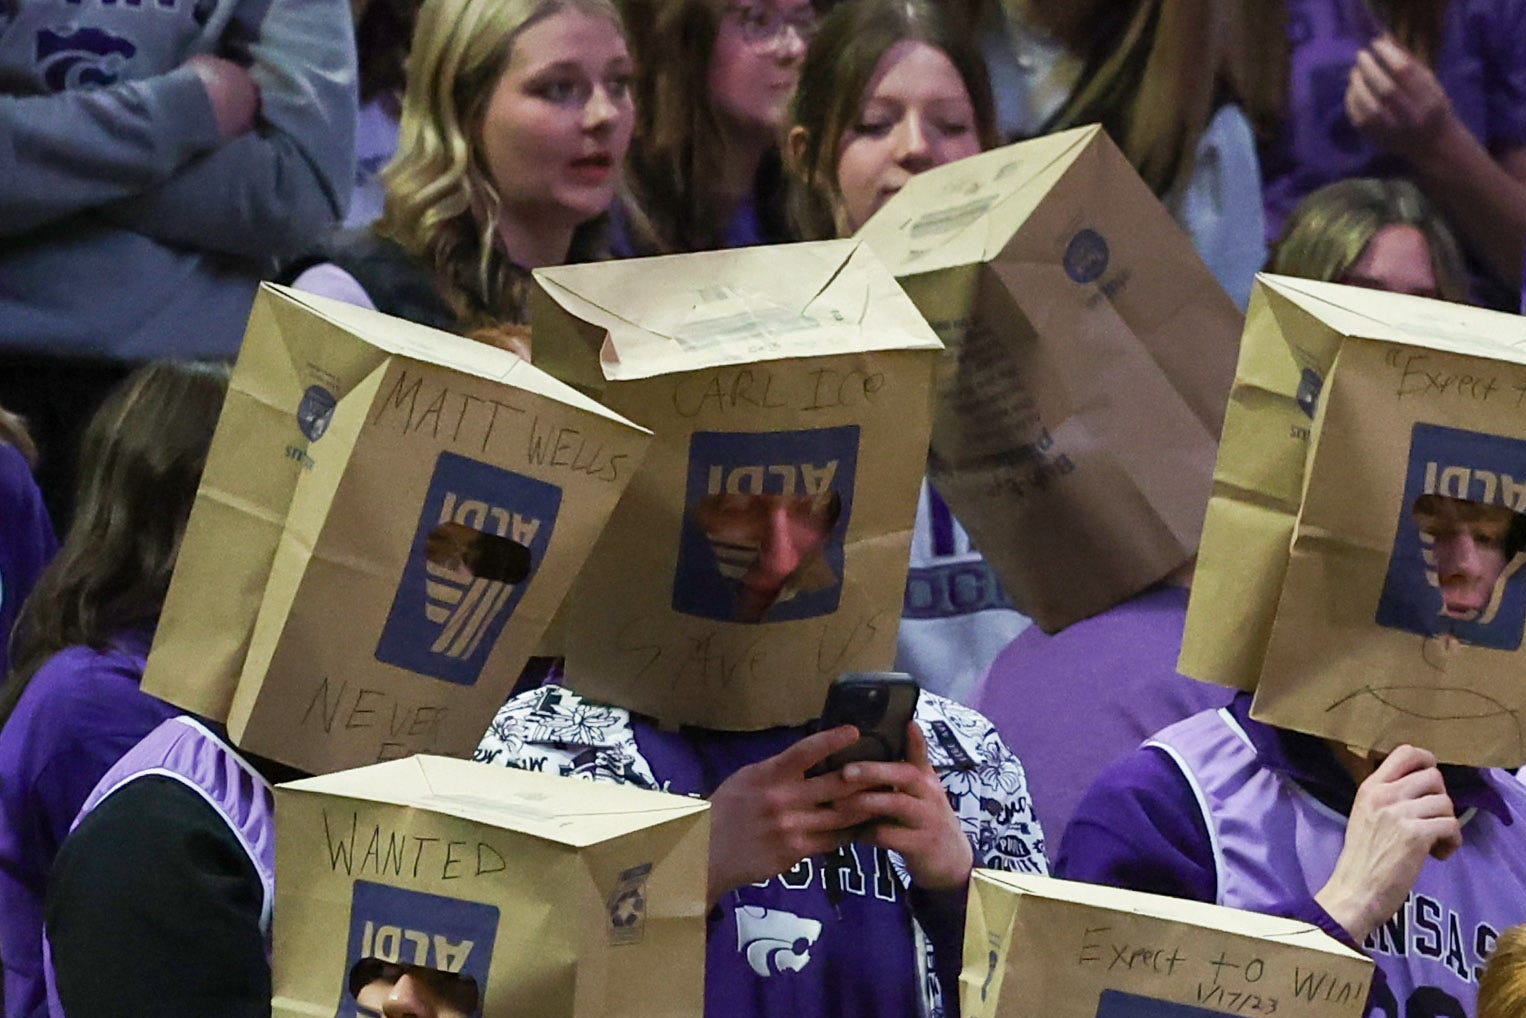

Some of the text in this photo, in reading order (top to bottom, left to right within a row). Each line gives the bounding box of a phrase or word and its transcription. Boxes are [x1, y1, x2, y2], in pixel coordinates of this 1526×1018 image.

[673, 369, 789, 418] CARL
[374, 371, 629, 482] MATT WELLS
[708, 459, 838, 504] ALDI
[438, 492, 541, 547] ALDI
[301, 677, 450, 747] NEVER
[322, 807, 507, 880] WANTED
[361, 920, 474, 973] ALDI
[1078, 926, 1186, 977] Expect
[1209, 950, 1264, 985] to
[1363, 893, 1499, 985] NSAS
[1197, 982, 1278, 1015] 1/17/23
